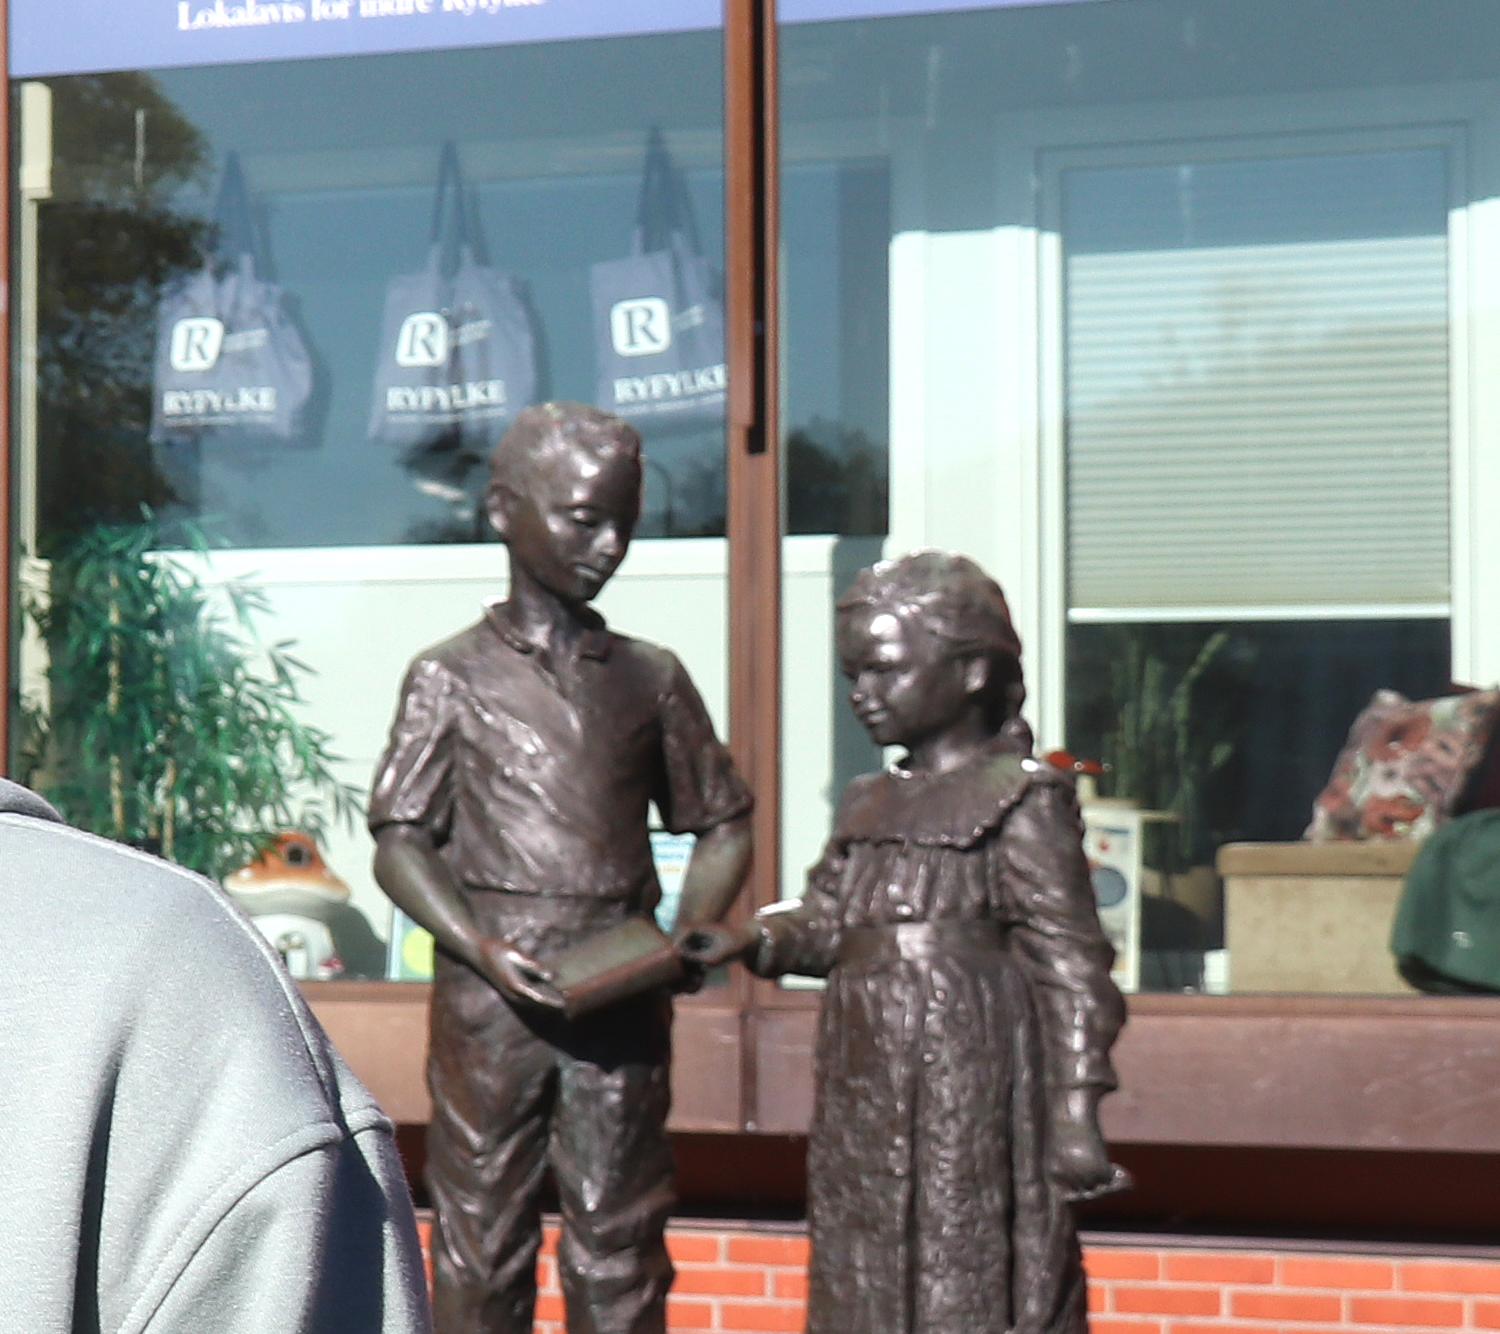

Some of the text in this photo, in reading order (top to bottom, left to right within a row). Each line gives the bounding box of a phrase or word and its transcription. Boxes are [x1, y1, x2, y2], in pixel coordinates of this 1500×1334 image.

[179, 323, 210, 364] R
[404, 322, 438, 360] R
[622, 305, 662, 347] R
